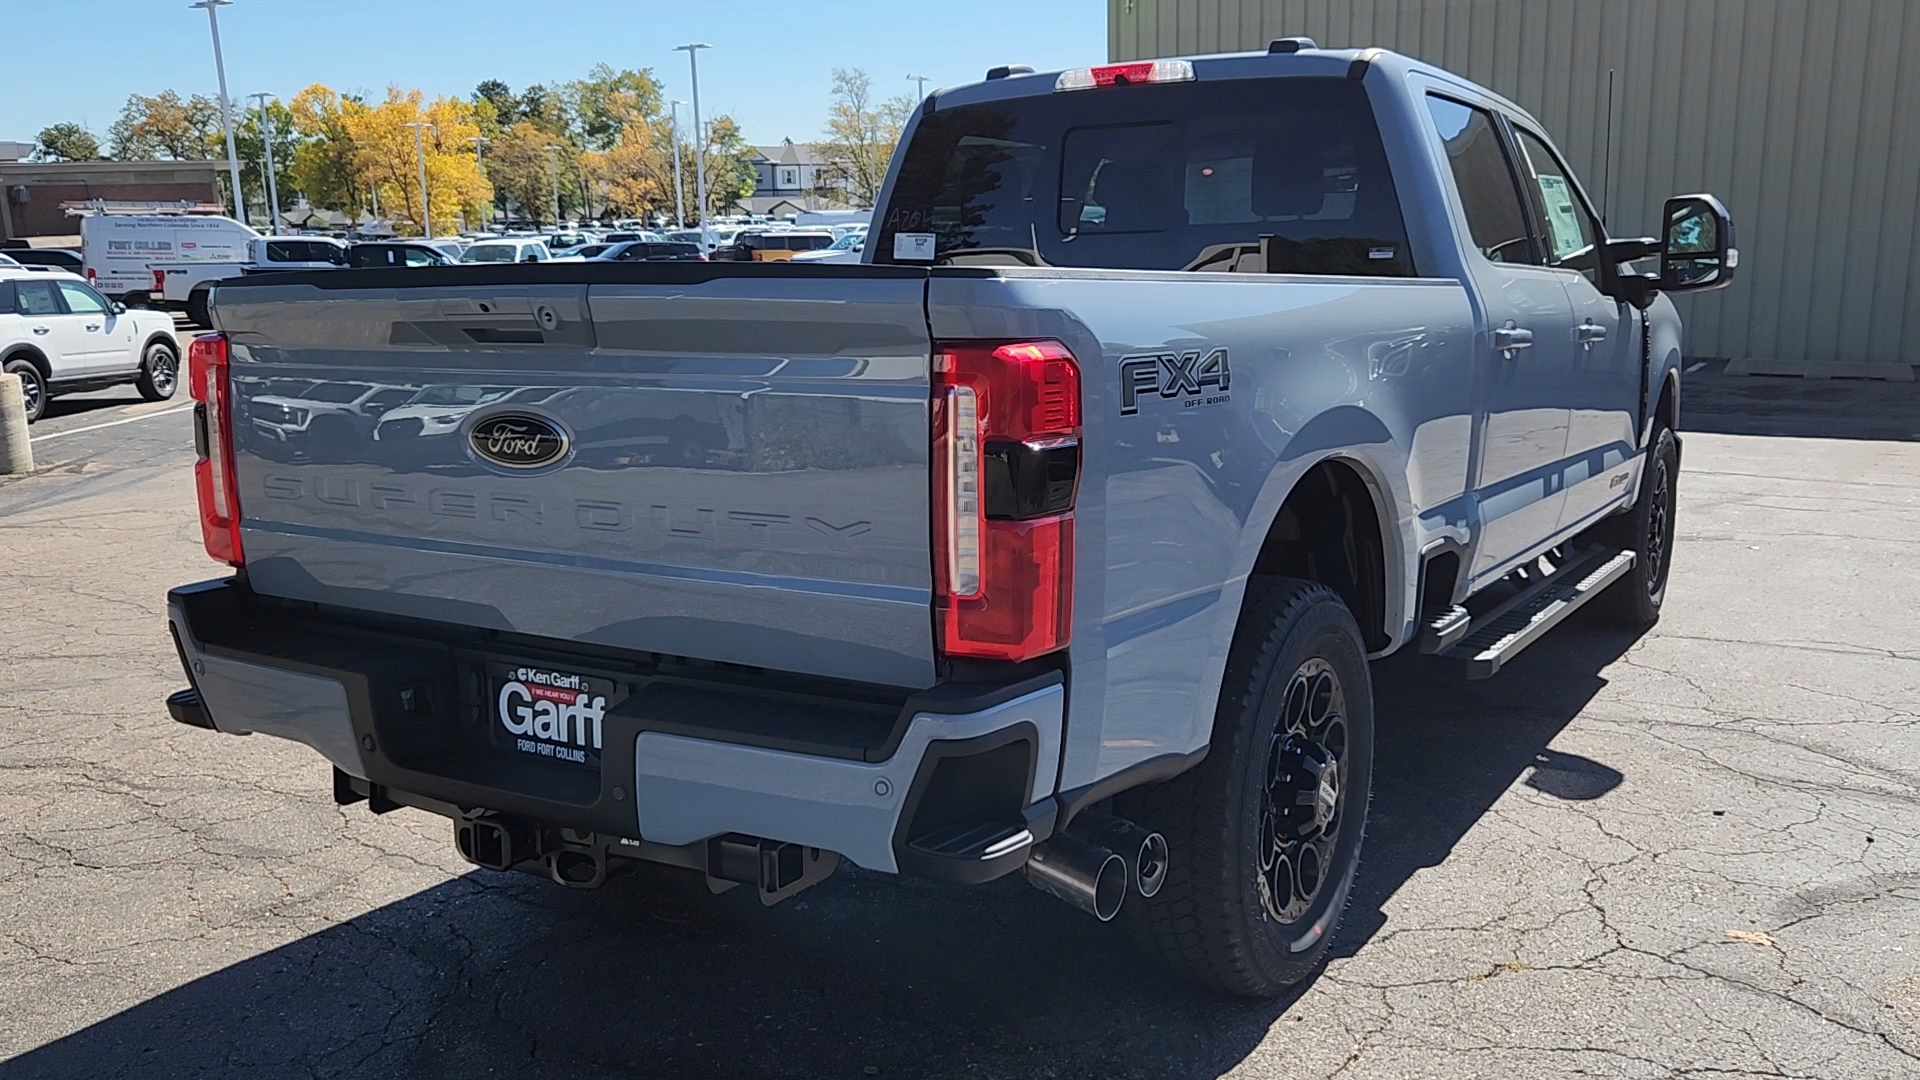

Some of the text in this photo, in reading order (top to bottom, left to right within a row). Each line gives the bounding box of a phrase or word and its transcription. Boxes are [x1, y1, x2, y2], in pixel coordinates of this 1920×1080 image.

[108, 240, 133, 250] FORT
[134, 241, 172, 251] COLLINS
[1119, 348, 1231, 416] FX4
[1185, 395, 1231, 408] OFF ROAD
[488, 423, 541, 456] Ford
[263, 473, 872, 552] SUPER DUTY
[527, 668, 580, 690] Ken Garff
[535, 688, 571, 700] WE HEAR YOU
[499, 681, 606, 749] Garff
[517, 739, 585, 763] FORD FORT COLLINS
